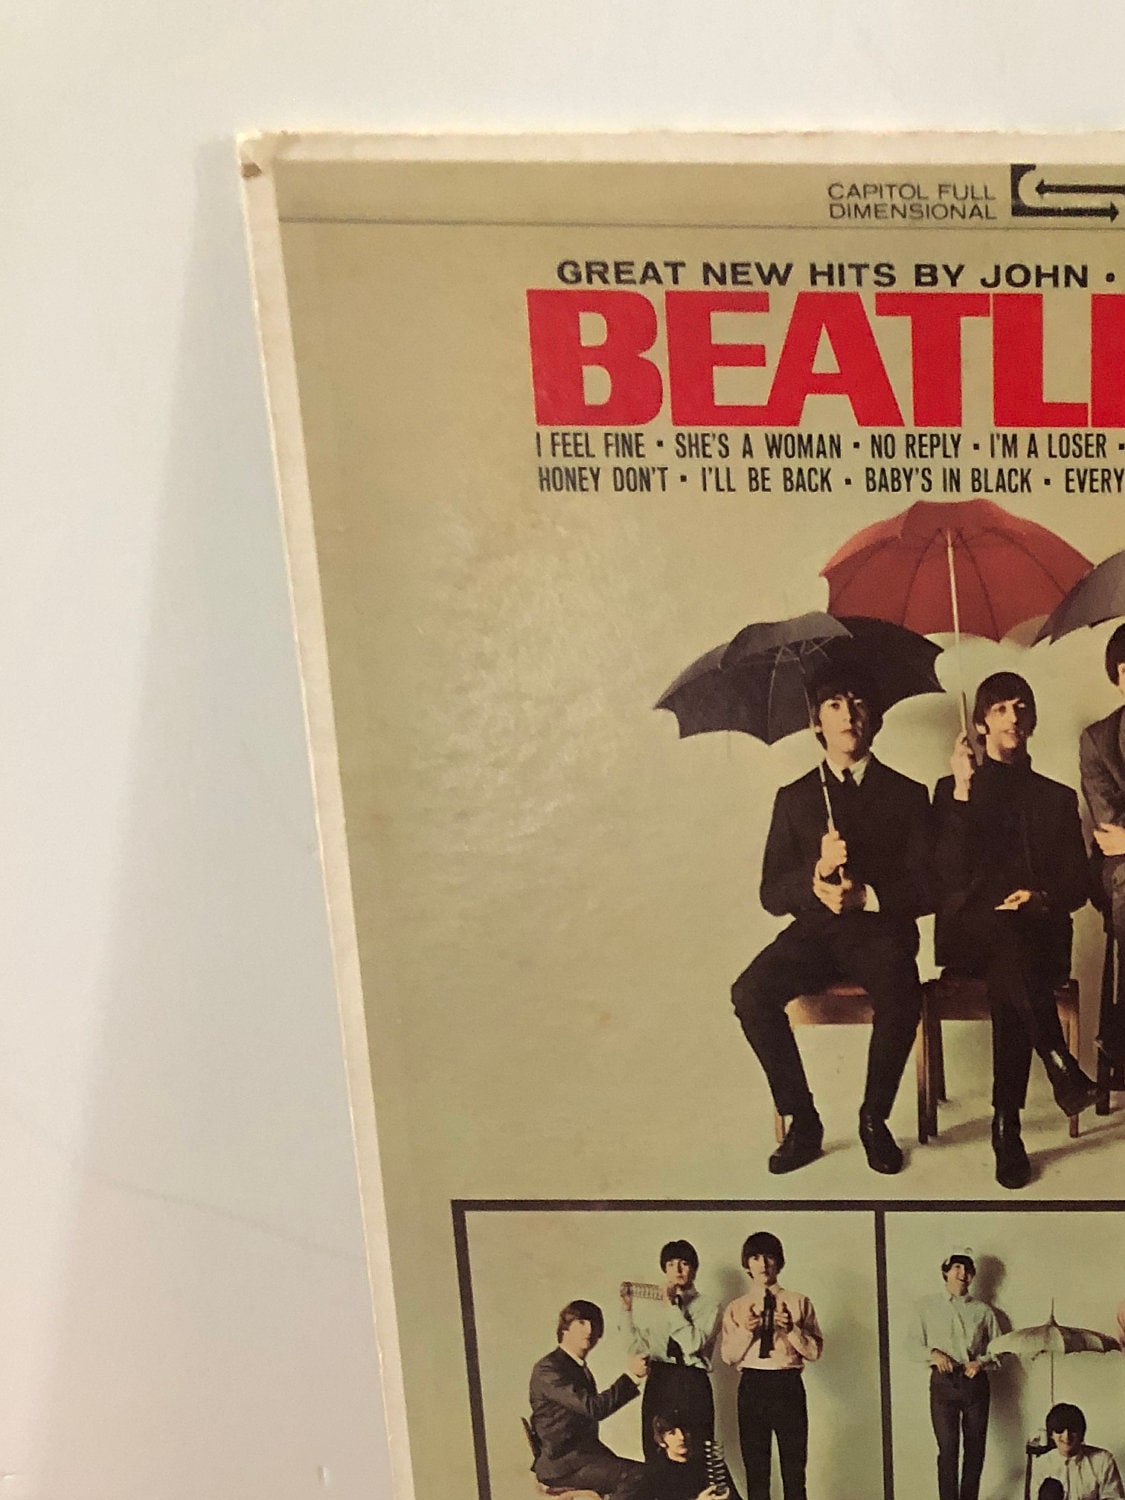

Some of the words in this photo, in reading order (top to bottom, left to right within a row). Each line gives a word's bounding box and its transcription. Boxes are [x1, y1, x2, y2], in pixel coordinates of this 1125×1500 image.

[827, 182, 930, 202] CAPITOL
[937, 183, 997, 202] FULL
[828, 202, 998, 221] DIMENSIONAL
[556, 260, 686, 287] GREAT
[702, 261, 794, 288] NEW
[809, 262, 897, 288] HITS
[914, 263, 965, 288] BY
[980, 263, 1089, 289] JOHN
[535, 431, 542, 458] I
[550, 431, 596, 459] FEEL
[603, 432, 646, 459] FINE
[674, 432, 730, 459] SHE'S
[741, 432, 754, 459] A
[764, 432, 842, 460] WOMAN
[870, 433, 896, 460] NO
[905, 432, 962, 460] REPLY
[989, 432, 1019, 459] I'M
[1026, 432, 1039, 459] A
[1047, 432, 1107, 459] LOSER
[538, 466, 601, 492] HONEY
[612, 466, 669, 493] DON'T
[701, 466, 737, 493] I'LL
[747, 466, 772, 493] BE
[782, 466, 833, 493] BACK
[865, 466, 933, 493] BABY'S
[942, 466, 961, 493] IN
[970, 467, 1032, 494] BLACK
